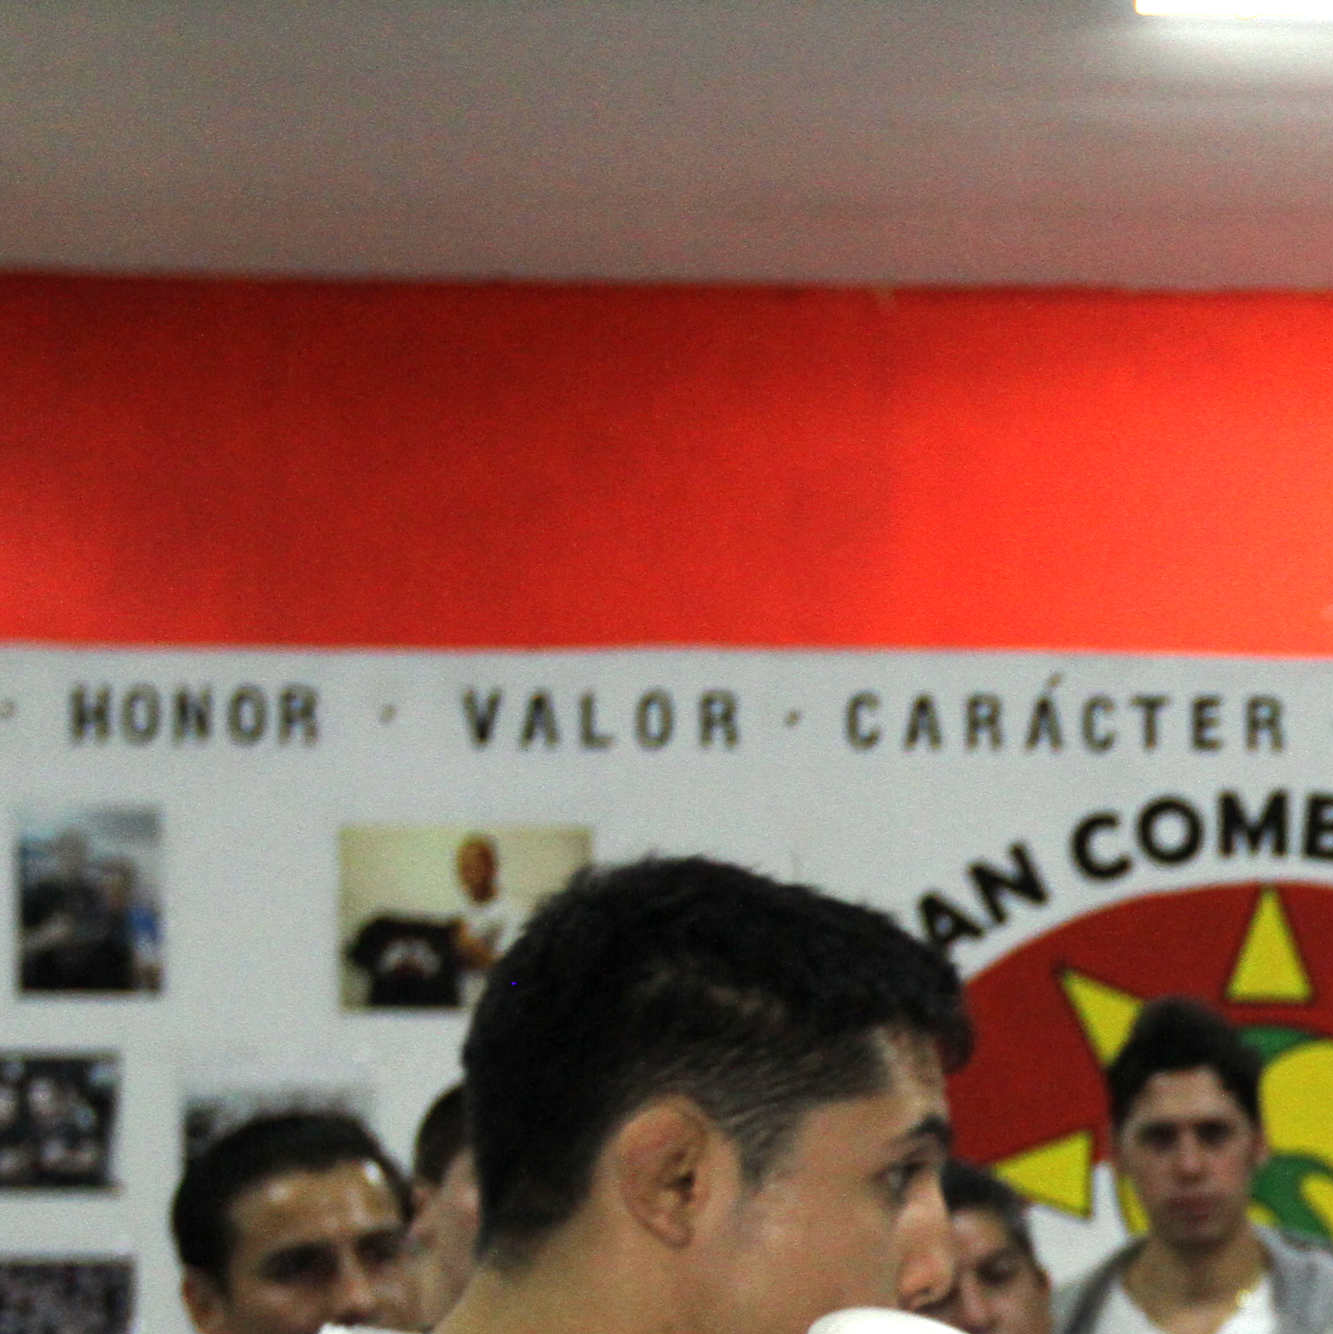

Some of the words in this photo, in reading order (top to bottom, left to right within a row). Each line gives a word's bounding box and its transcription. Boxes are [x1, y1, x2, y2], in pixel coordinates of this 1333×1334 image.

[67, 682, 321, 748] HONOR
[459, 685, 741, 752] VALOR
[844, 674, 1285, 756] CARÁCTER
